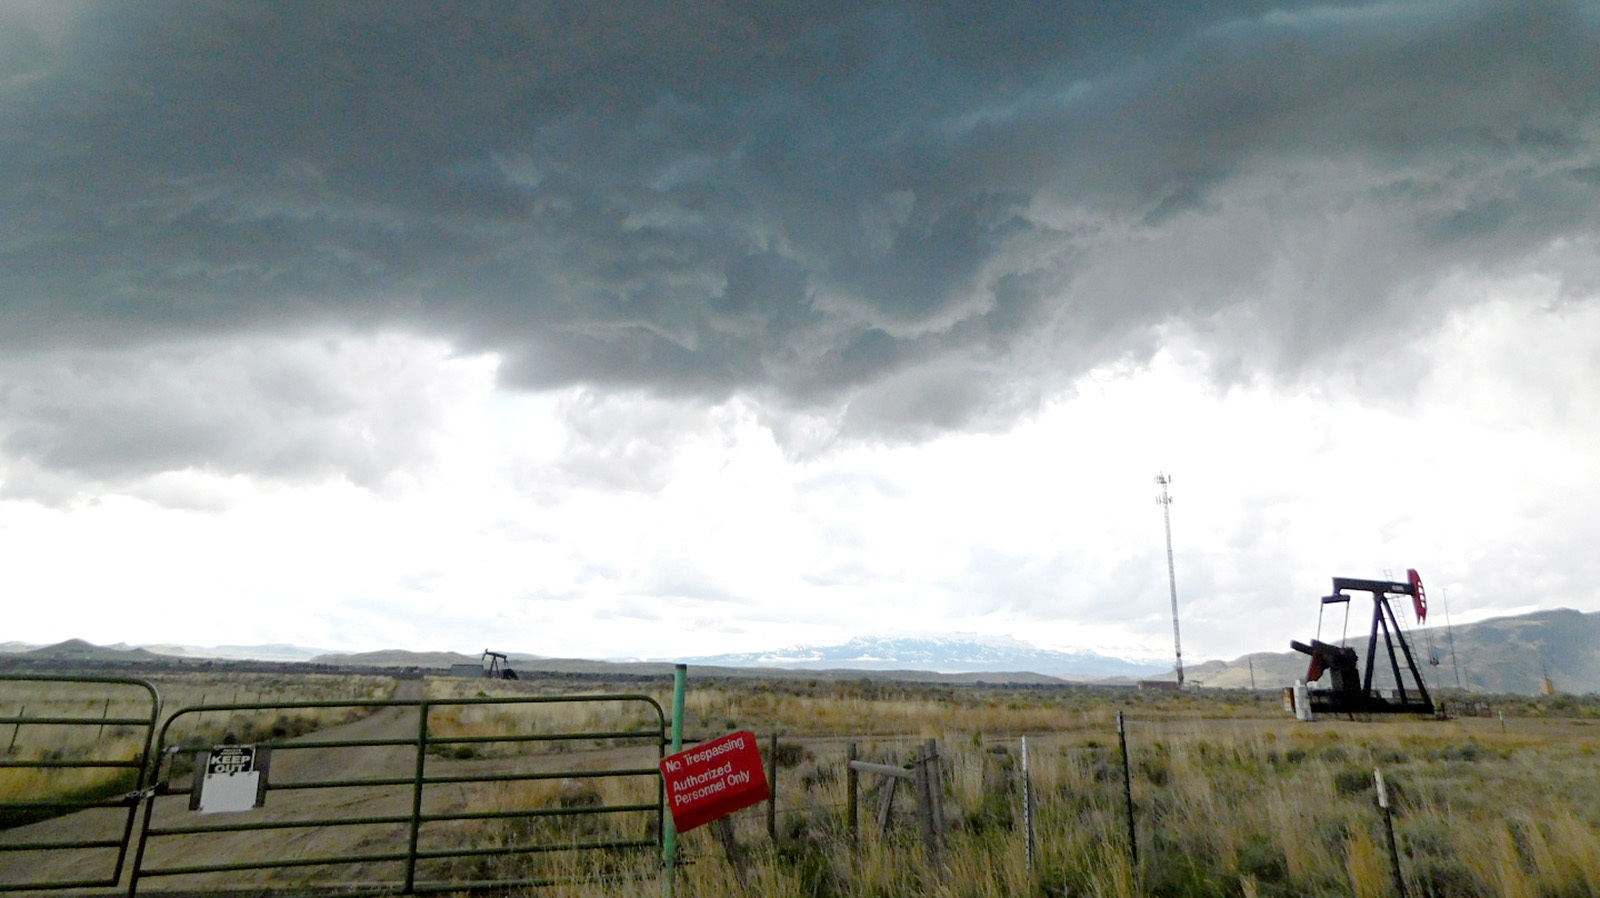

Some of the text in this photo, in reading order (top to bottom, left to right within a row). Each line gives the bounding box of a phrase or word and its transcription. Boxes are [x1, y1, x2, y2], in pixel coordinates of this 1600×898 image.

[211, 755, 251, 764] KEEP
[214, 764, 246, 773] OUT
[665, 737, 744, 773] No Trespassing
[673, 761, 732, 792] Authorized
[675, 770, 749, 806] Personnel Only
